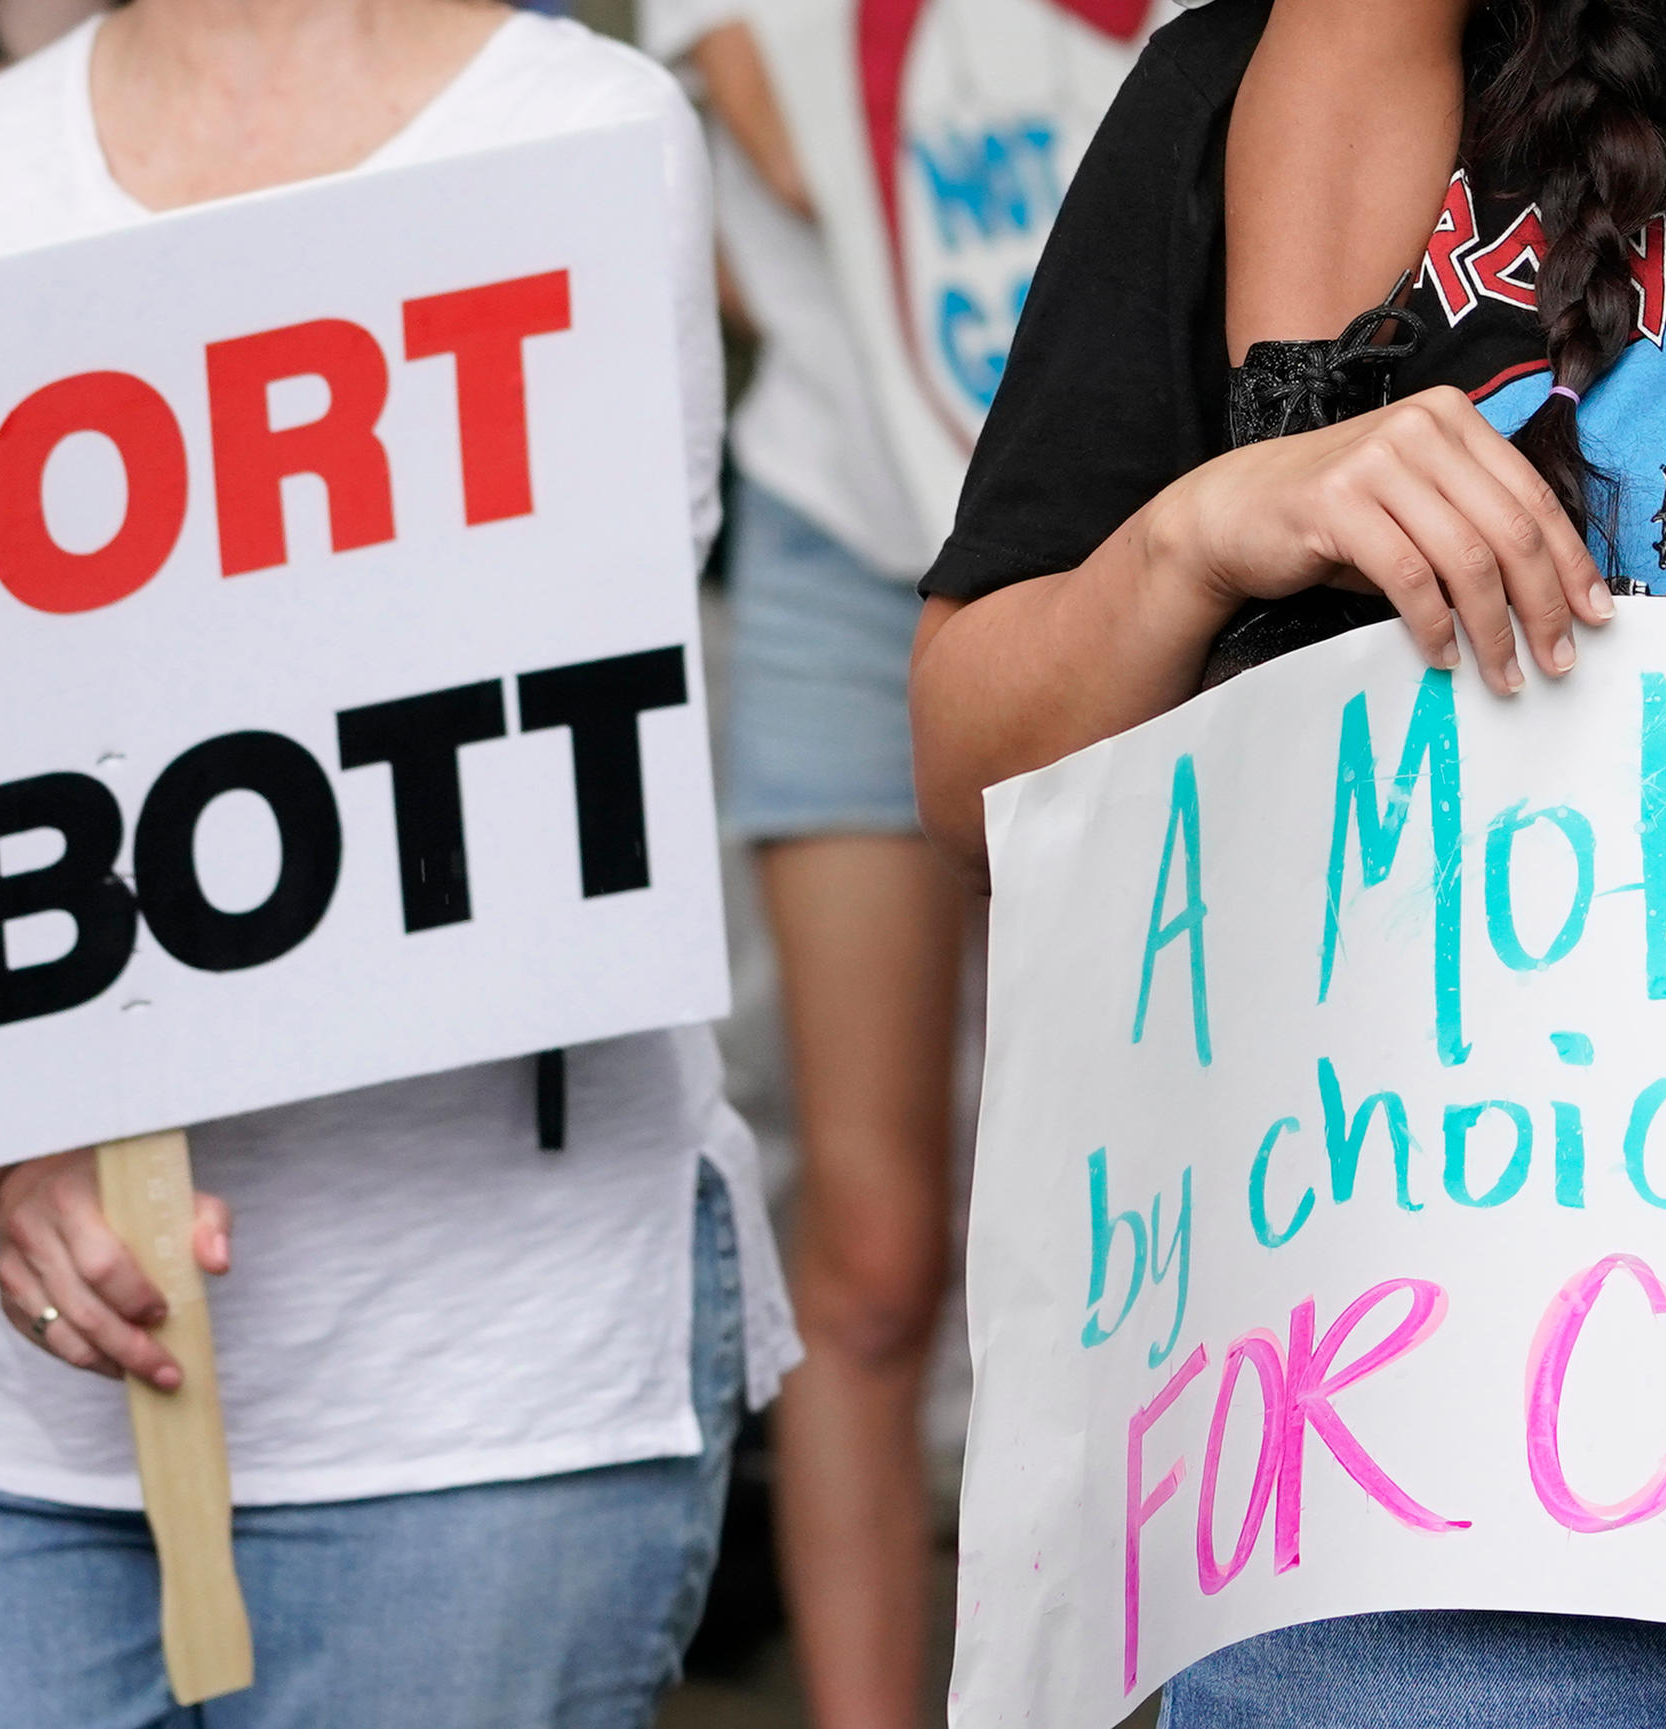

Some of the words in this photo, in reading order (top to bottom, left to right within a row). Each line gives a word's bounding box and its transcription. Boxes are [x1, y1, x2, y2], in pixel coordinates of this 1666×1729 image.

[1131, 753, 1213, 1068] A
[1079, 1145, 1194, 1370] by
[1123, 1276, 1475, 1697] FOR
